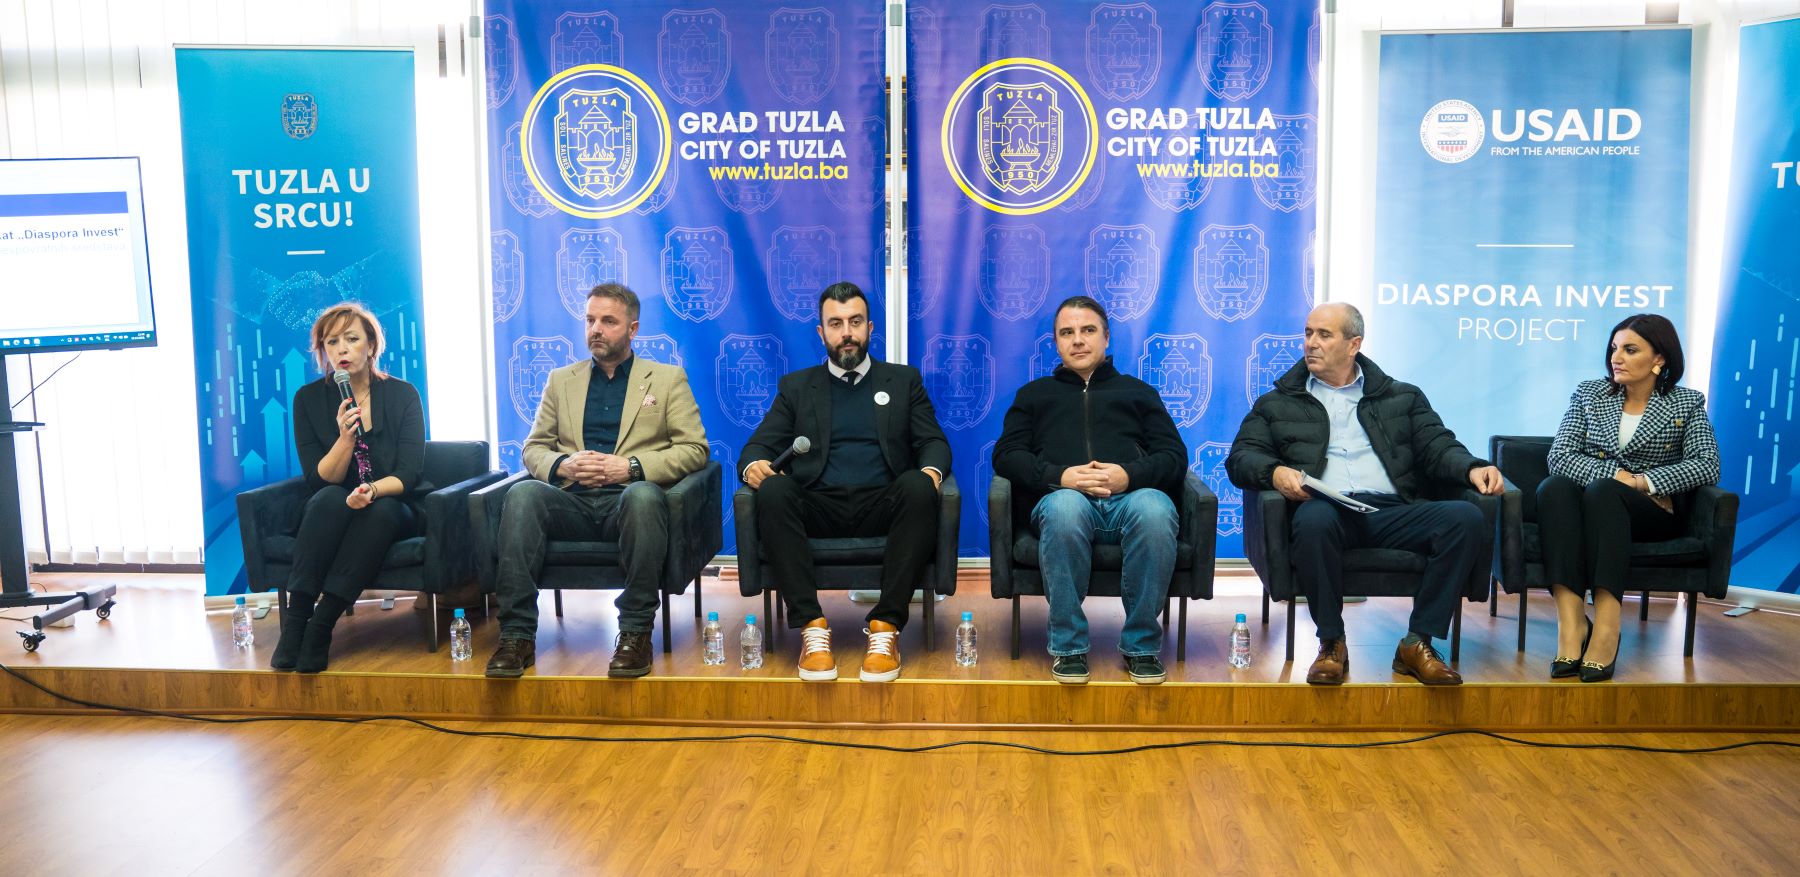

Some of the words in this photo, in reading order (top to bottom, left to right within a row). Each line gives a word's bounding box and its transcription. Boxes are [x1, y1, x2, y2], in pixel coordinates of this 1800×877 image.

[572, 96, 618, 108] TUZLA
[996, 90, 1044, 102] TUZLA
[678, 111, 758, 134] GRAD
[764, 110, 846, 133] TUZLA
[1106, 107, 1188, 130] GRAD
[1196, 107, 1277, 130] TUZLA
[1492, 108, 1642, 142] USAID
[680, 140, 734, 160] CITY
[738, 140, 771, 160] OF
[776, 139, 847, 160] TUZLA
[1106, 136, 1163, 157] CITY
[1168, 136, 1201, 157] OF
[1206, 136, 1278, 157] TUZLA
[1490, 146, 1520, 156] FROM
[1522, 146, 1542, 156] THE
[1544, 146, 1600, 156] AMERICAN
[1602, 146, 1640, 156] PEOPLE
[708, 162, 848, 181] www.tuzla.ba
[1007, 170, 1034, 180] 950
[1136, 160, 1280, 178] www.tuzla.ba
[232, 168, 340, 195] TUZLA
[349, 168, 370, 193] U
[584, 175, 610, 184] 950
[253, 200, 354, 229] SRCU!
[1102, 230, 1142, 240] TUZLA
[1210, 230, 1252, 240] TUZLA
[1378, 282, 1543, 308] DIASPORA
[1554, 284, 1674, 309] INVEST
[1458, 317, 1586, 346] PROJECT
[634, 340, 665, 351] UZLA
[1155, 340, 1196, 350] TUZLA
